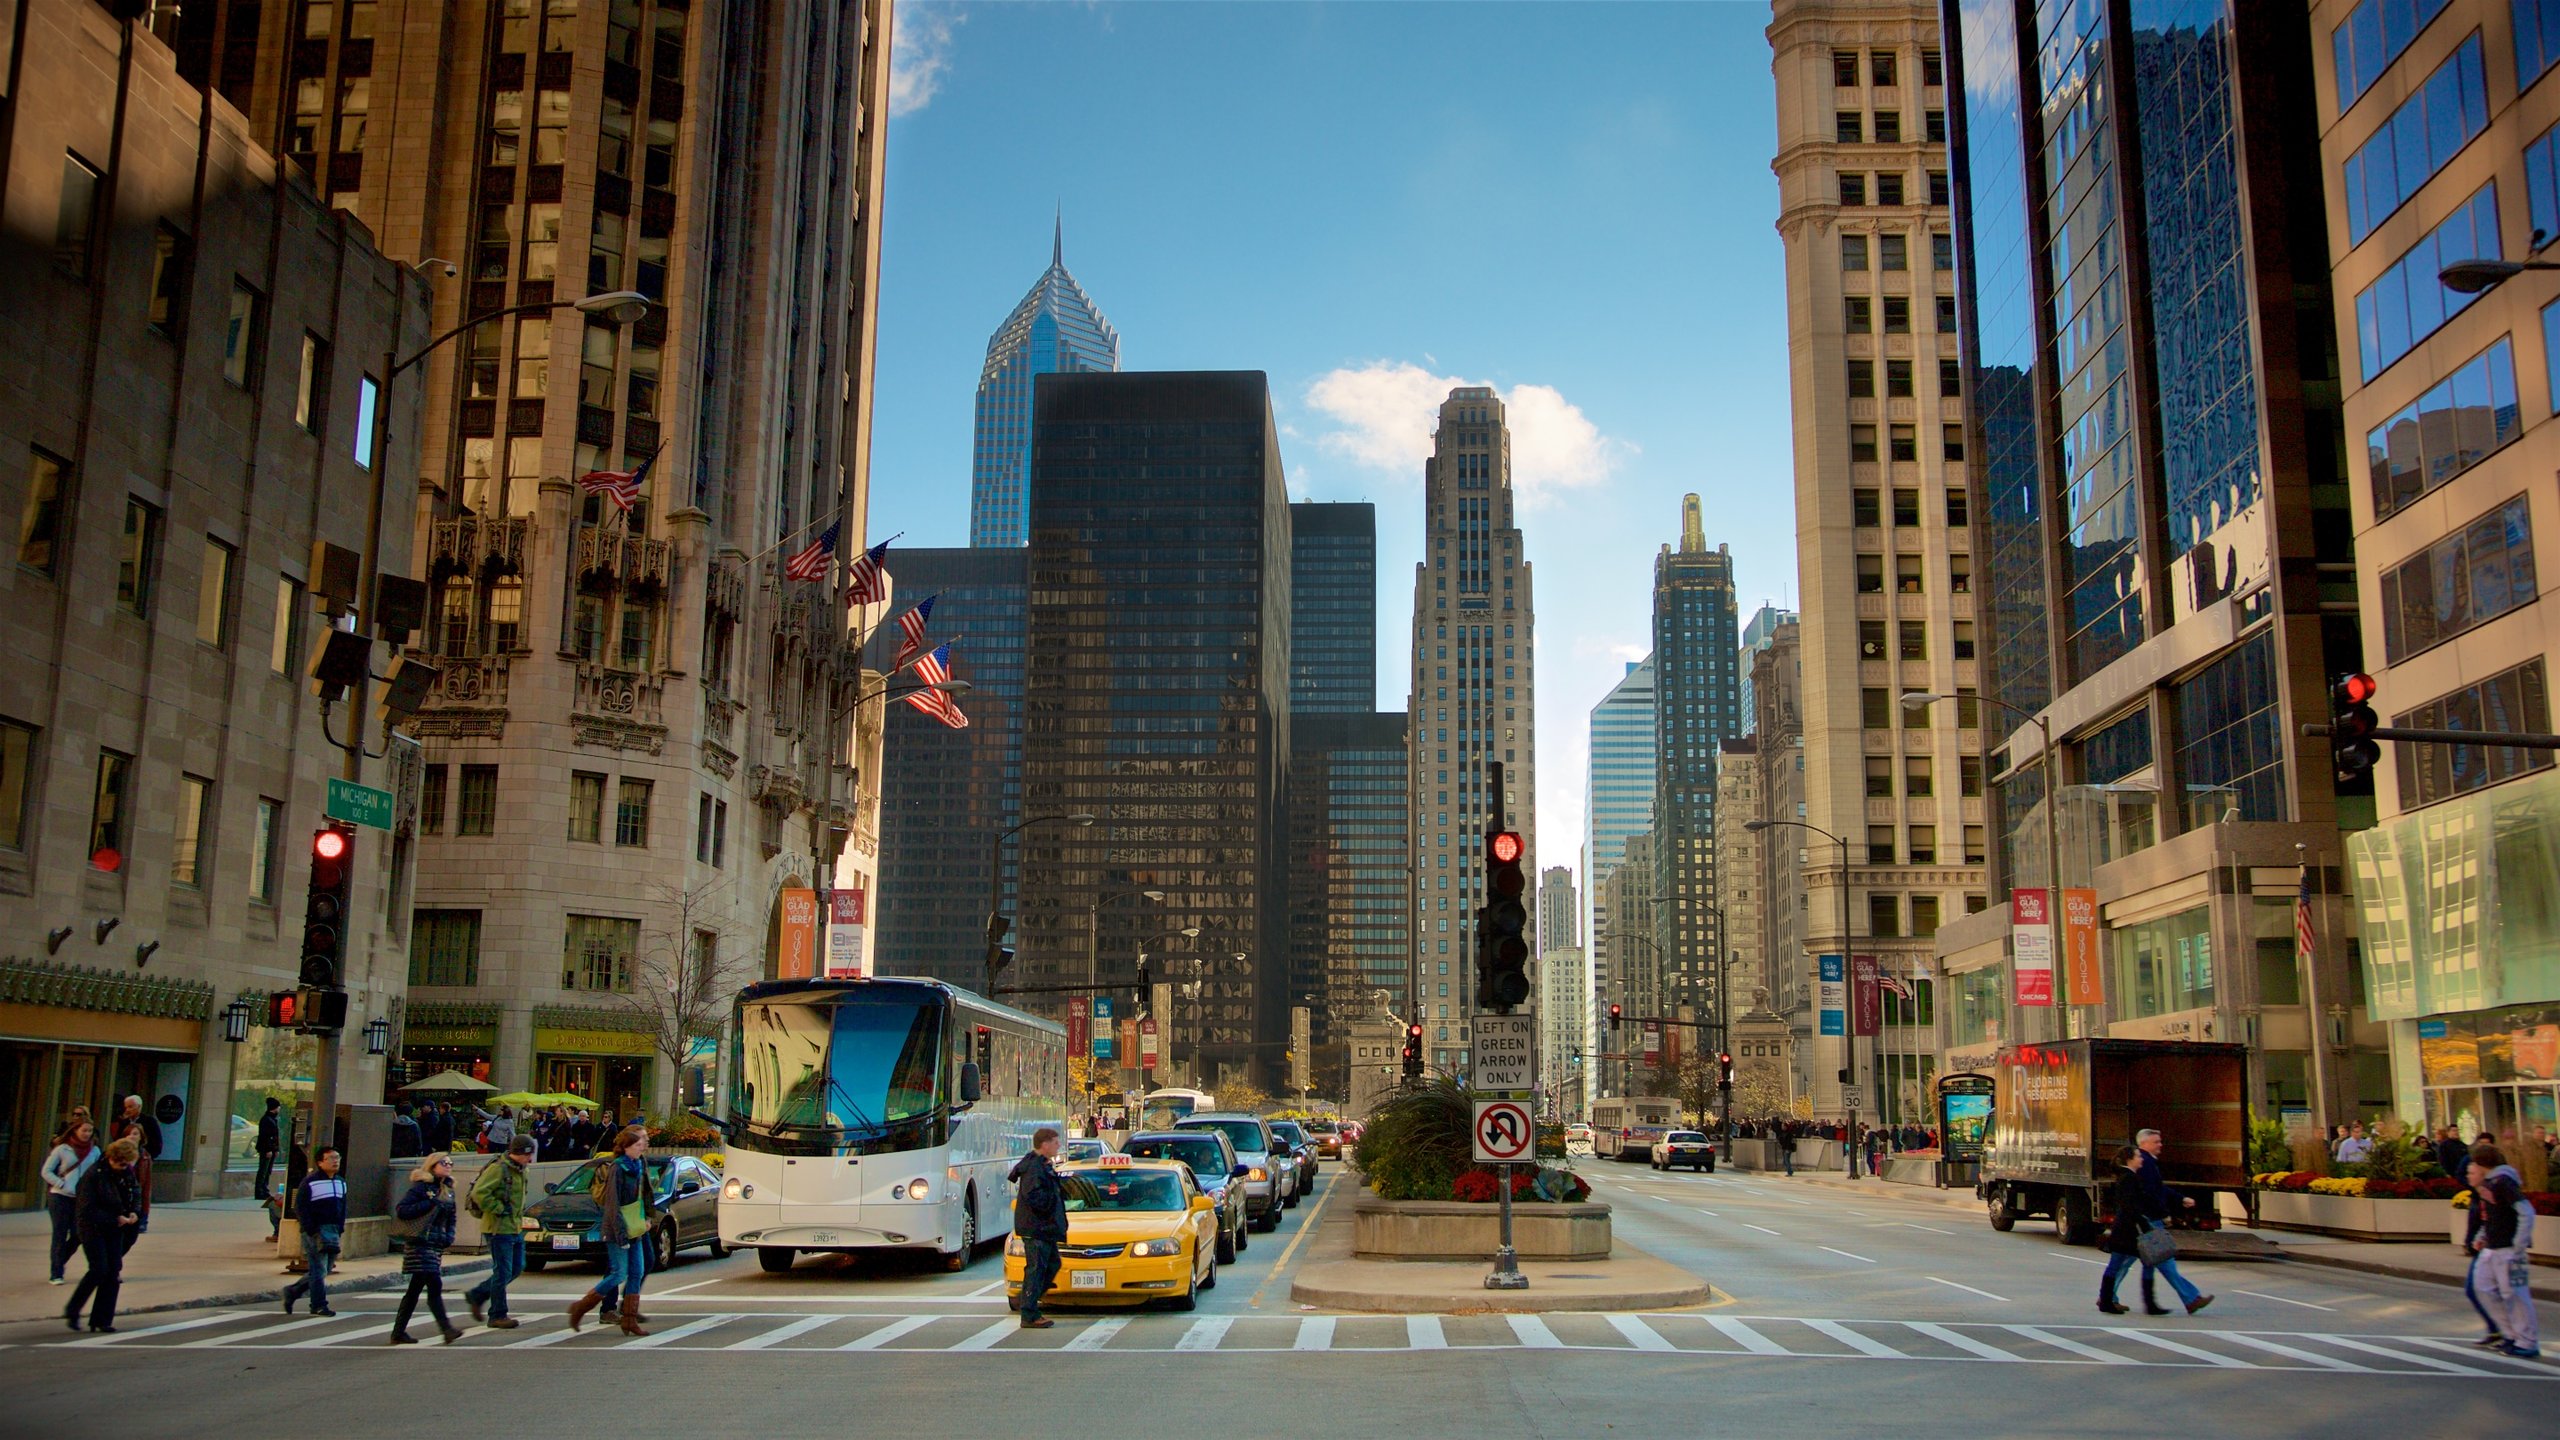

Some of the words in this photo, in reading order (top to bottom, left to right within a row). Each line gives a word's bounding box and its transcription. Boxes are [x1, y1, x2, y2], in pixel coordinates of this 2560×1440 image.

[341, 786, 378, 809] MICHIGAN
[352, 807, 361, 818] 100
[787, 902, 810, 910] GLAD
[2068, 903, 2091, 911] GLAD
[788, 915, 813, 927] HERE!
[838, 910, 858, 920] HERE!
[2021, 910, 2043, 920] HERE!
[2070, 916, 2094, 929] HERE!
[792, 929, 802, 979] HICAGO
[2077, 930, 2090, 994] CHICAGO
[1858, 975, 1876, 984] HERE!
[1863, 984, 1871, 1029] CHICAGO
[455, 1027, 480, 1040] café
[1475, 1022, 1505, 1034] LEFT
[1511, 1021, 1529, 1033] ON
[567, 1036, 593, 1047] argo
[595, 1036, 613, 1046] tea
[1481, 1038, 1525, 1050] GREEN
[1479, 1055, 1527, 1067] ARROW
[1487, 1072, 1522, 1084] ONLY
[2027, 1075, 2068, 1088] FLOORING
[2013, 1065, 2031, 1120] R
[2027, 1088, 2068, 1100] RESOURCES
[1845, 1097, 1861, 1107] 30
[1102, 1157, 1130, 1165] TAXI
[1073, 1276, 1081, 1285] 30
[1096, 1275, 1104, 1284] TX
